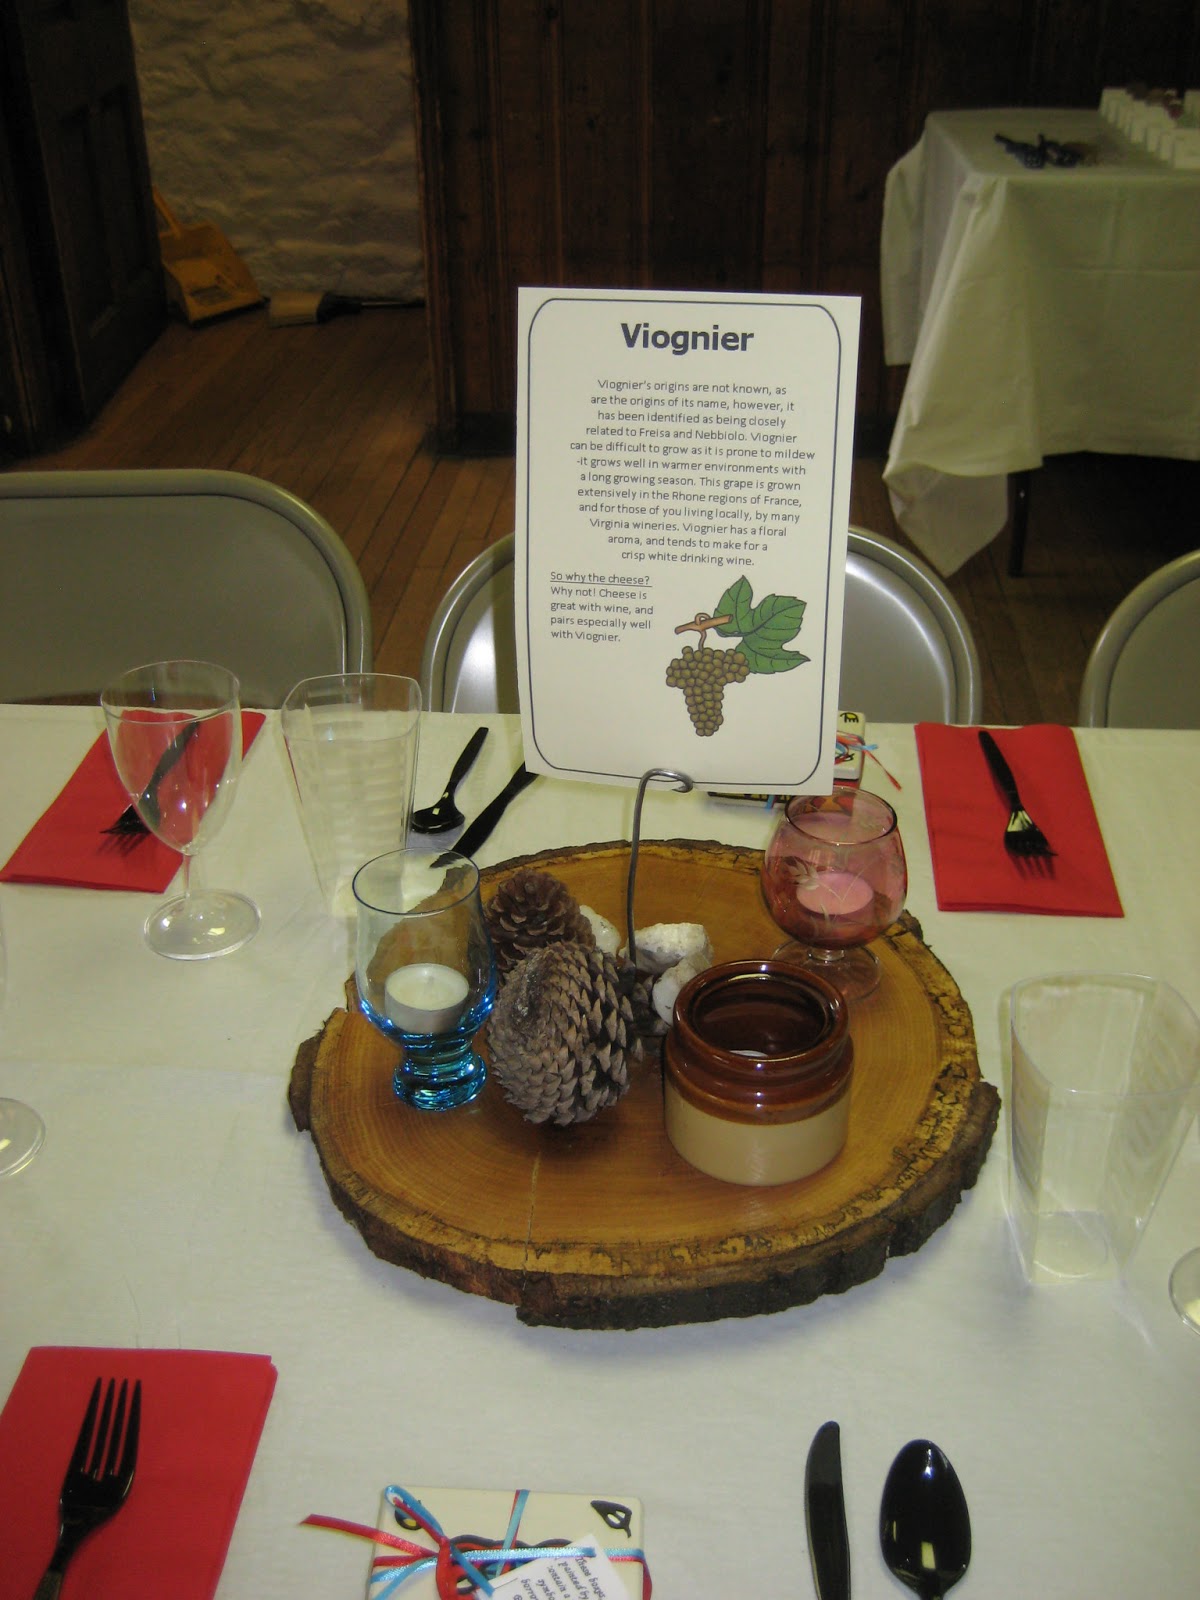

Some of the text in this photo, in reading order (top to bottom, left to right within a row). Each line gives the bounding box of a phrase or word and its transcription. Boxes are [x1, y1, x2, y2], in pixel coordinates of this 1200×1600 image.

[621, 322, 754, 355] Viognier
[597, 379, 787, 397] Viognier's origins are not known, as
[590, 394, 795, 413] are the origins of its name, however, it
[597, 409, 786, 430] has been identified as being closely
[585, 425, 798, 445] related to Freisa and Nebbiolo. Viognier
[569, 440, 816, 460] can be difficult to grow as it is prone to mildew
[576, 456, 806, 475] -it grows well in warmer environments with
[580, 471, 801, 493] a long growing season. This grape is grown
[577, 487, 802, 508] extensively in the Rhone regions of France,
[578, 502, 801, 525] and for those of you living locally, by many
[589, 518, 787, 537] Virginia wineries. Viognier has a floral
[607, 535, 768, 552] aroma, and tends to make for a
[621, 550, 754, 566] crisp white drinking wine.
[550, 571, 650, 586] So why the cheese?
[550, 585, 647, 600] Why not! Cheese is
[550, 602, 654, 615] great with wine, and
[550, 616, 651, 630] pairs especially well
[551, 629, 620, 644] with Viognier.
[558, 1560, 586, 1590] painted
